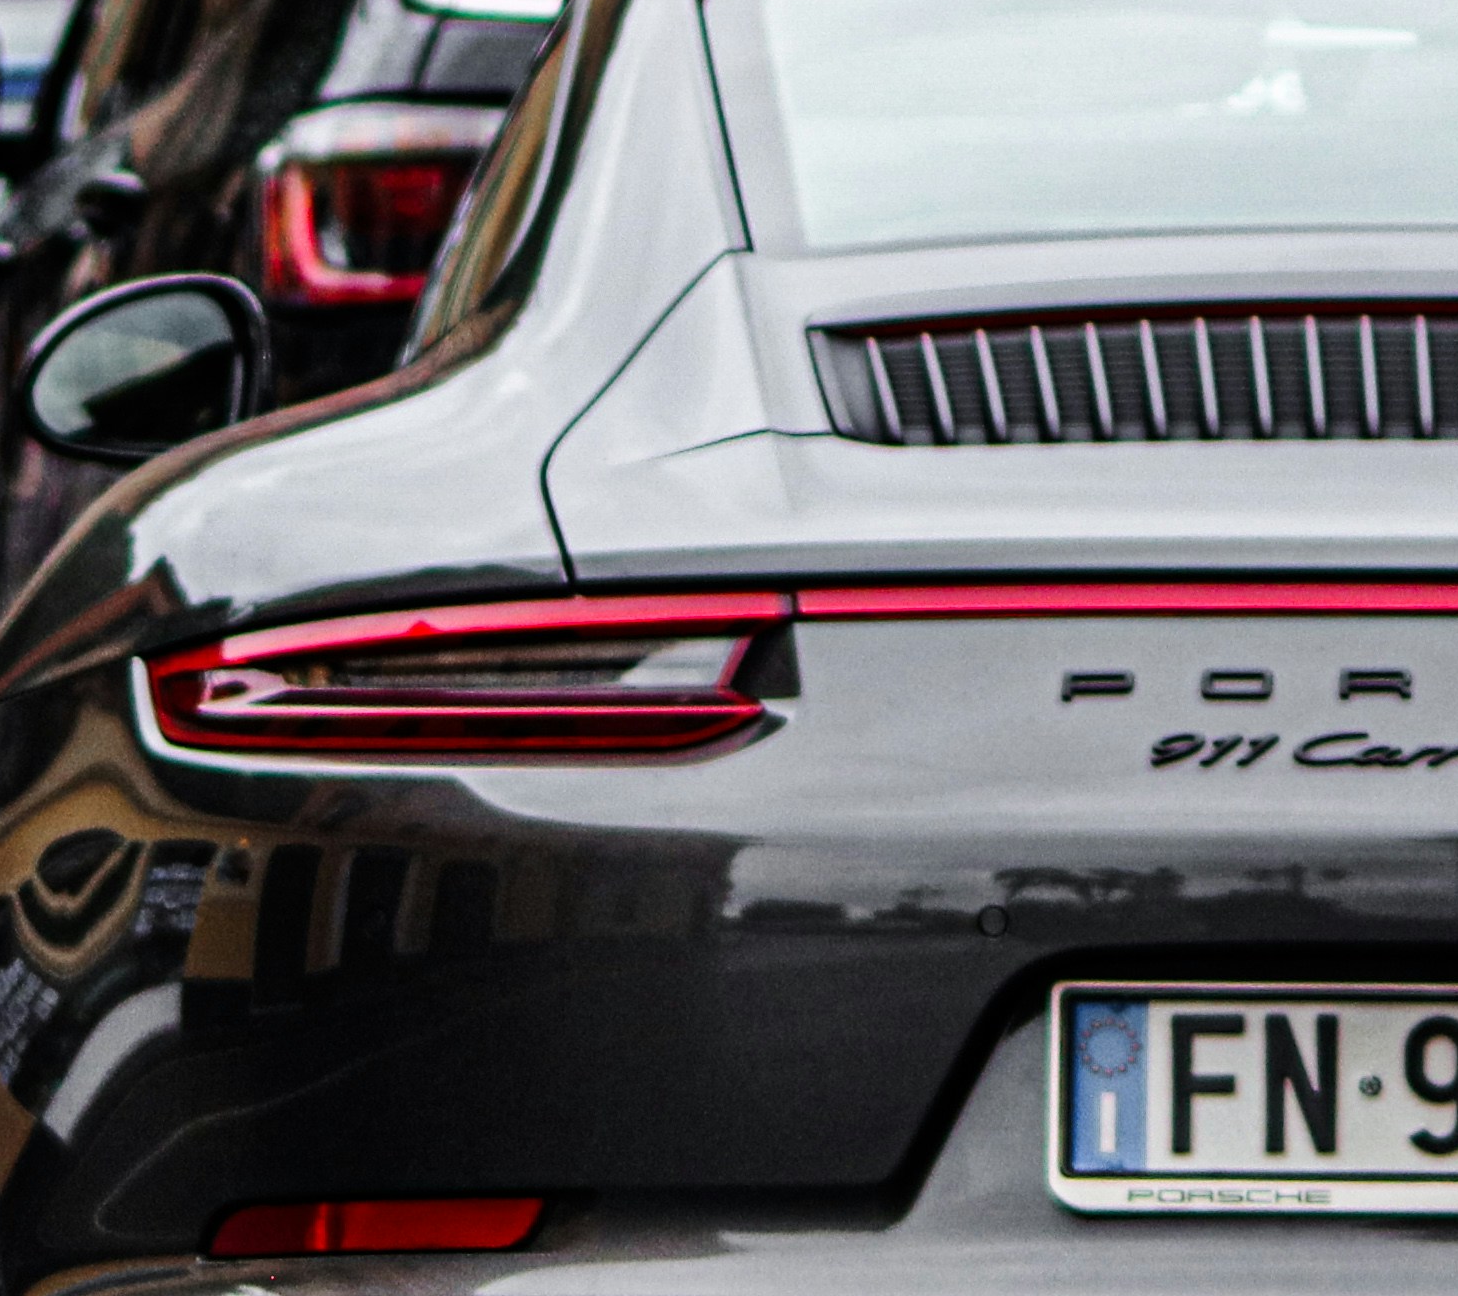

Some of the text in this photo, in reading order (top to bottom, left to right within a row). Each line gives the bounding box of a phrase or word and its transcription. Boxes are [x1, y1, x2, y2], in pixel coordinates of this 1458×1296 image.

[1150, 732, 1281, 769] 911
[1171, 1011, 1338, 1155] FN
[1126, 1188, 1332, 1204] PORSCHE
